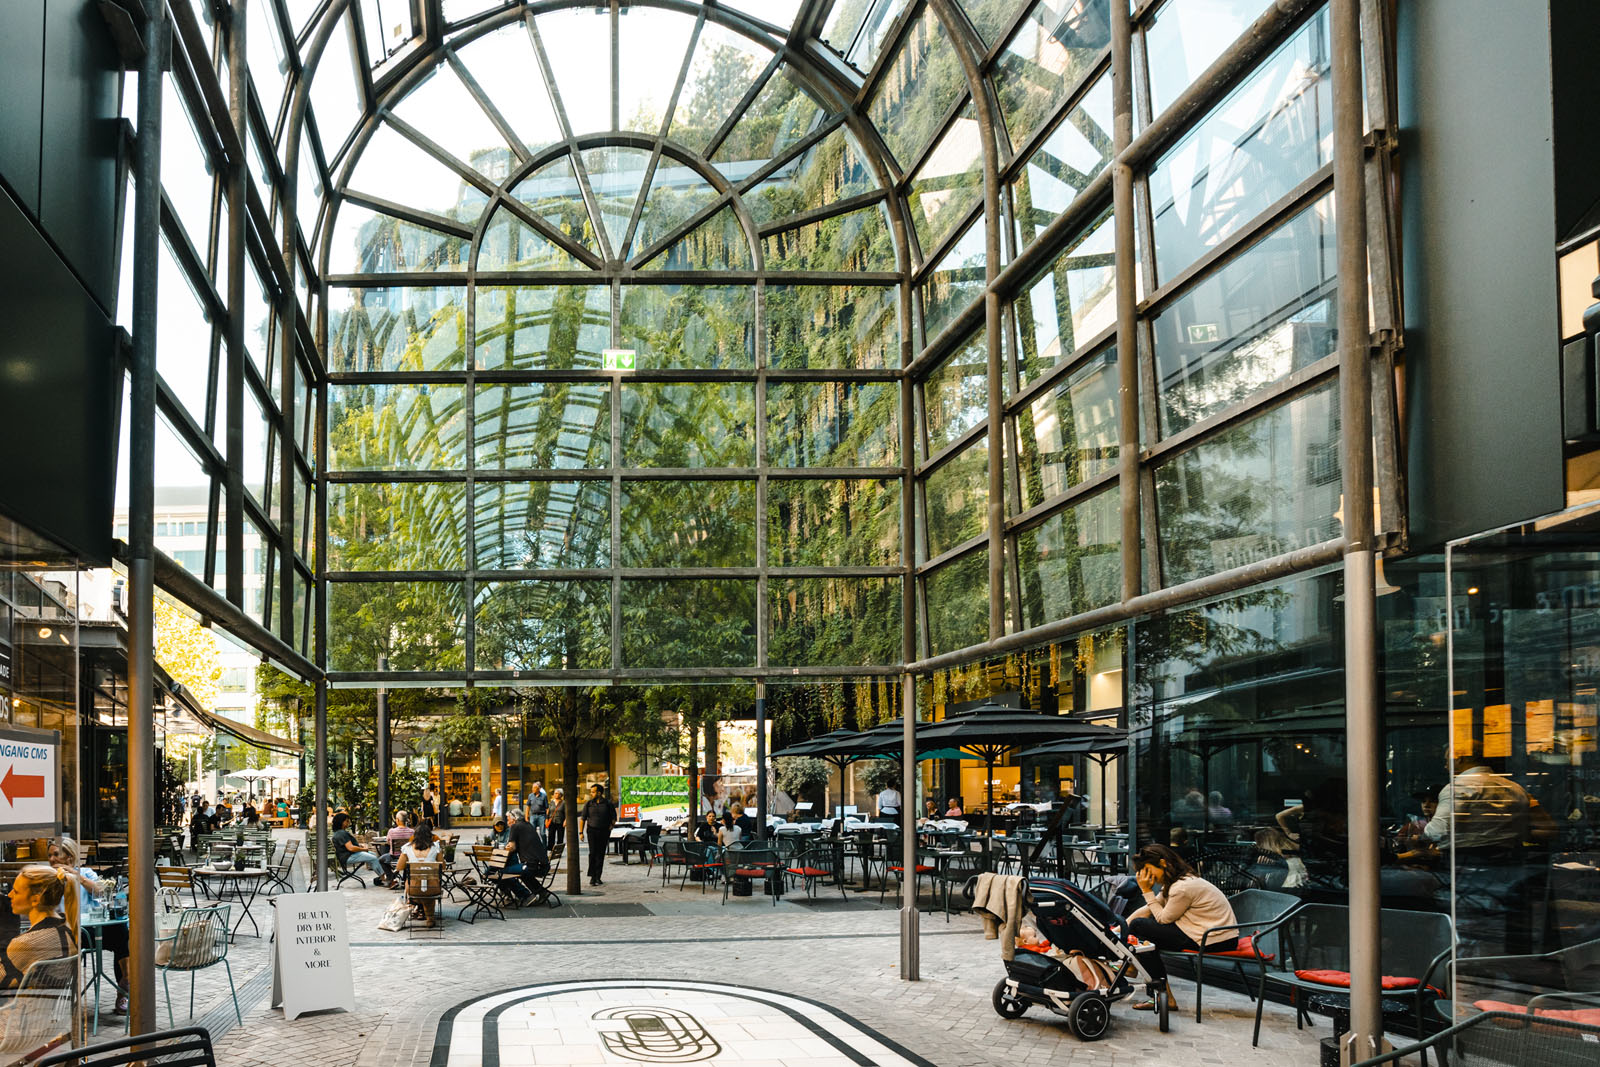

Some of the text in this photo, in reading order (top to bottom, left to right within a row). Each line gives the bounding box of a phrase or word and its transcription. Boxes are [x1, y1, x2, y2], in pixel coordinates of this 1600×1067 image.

[31, 747, 47, 760] CMS
[296, 924, 312, 932] DRY
[296, 935, 336, 944] INTERIOR
[313, 948, 321, 956] &
[305, 960, 332, 969] MORE
